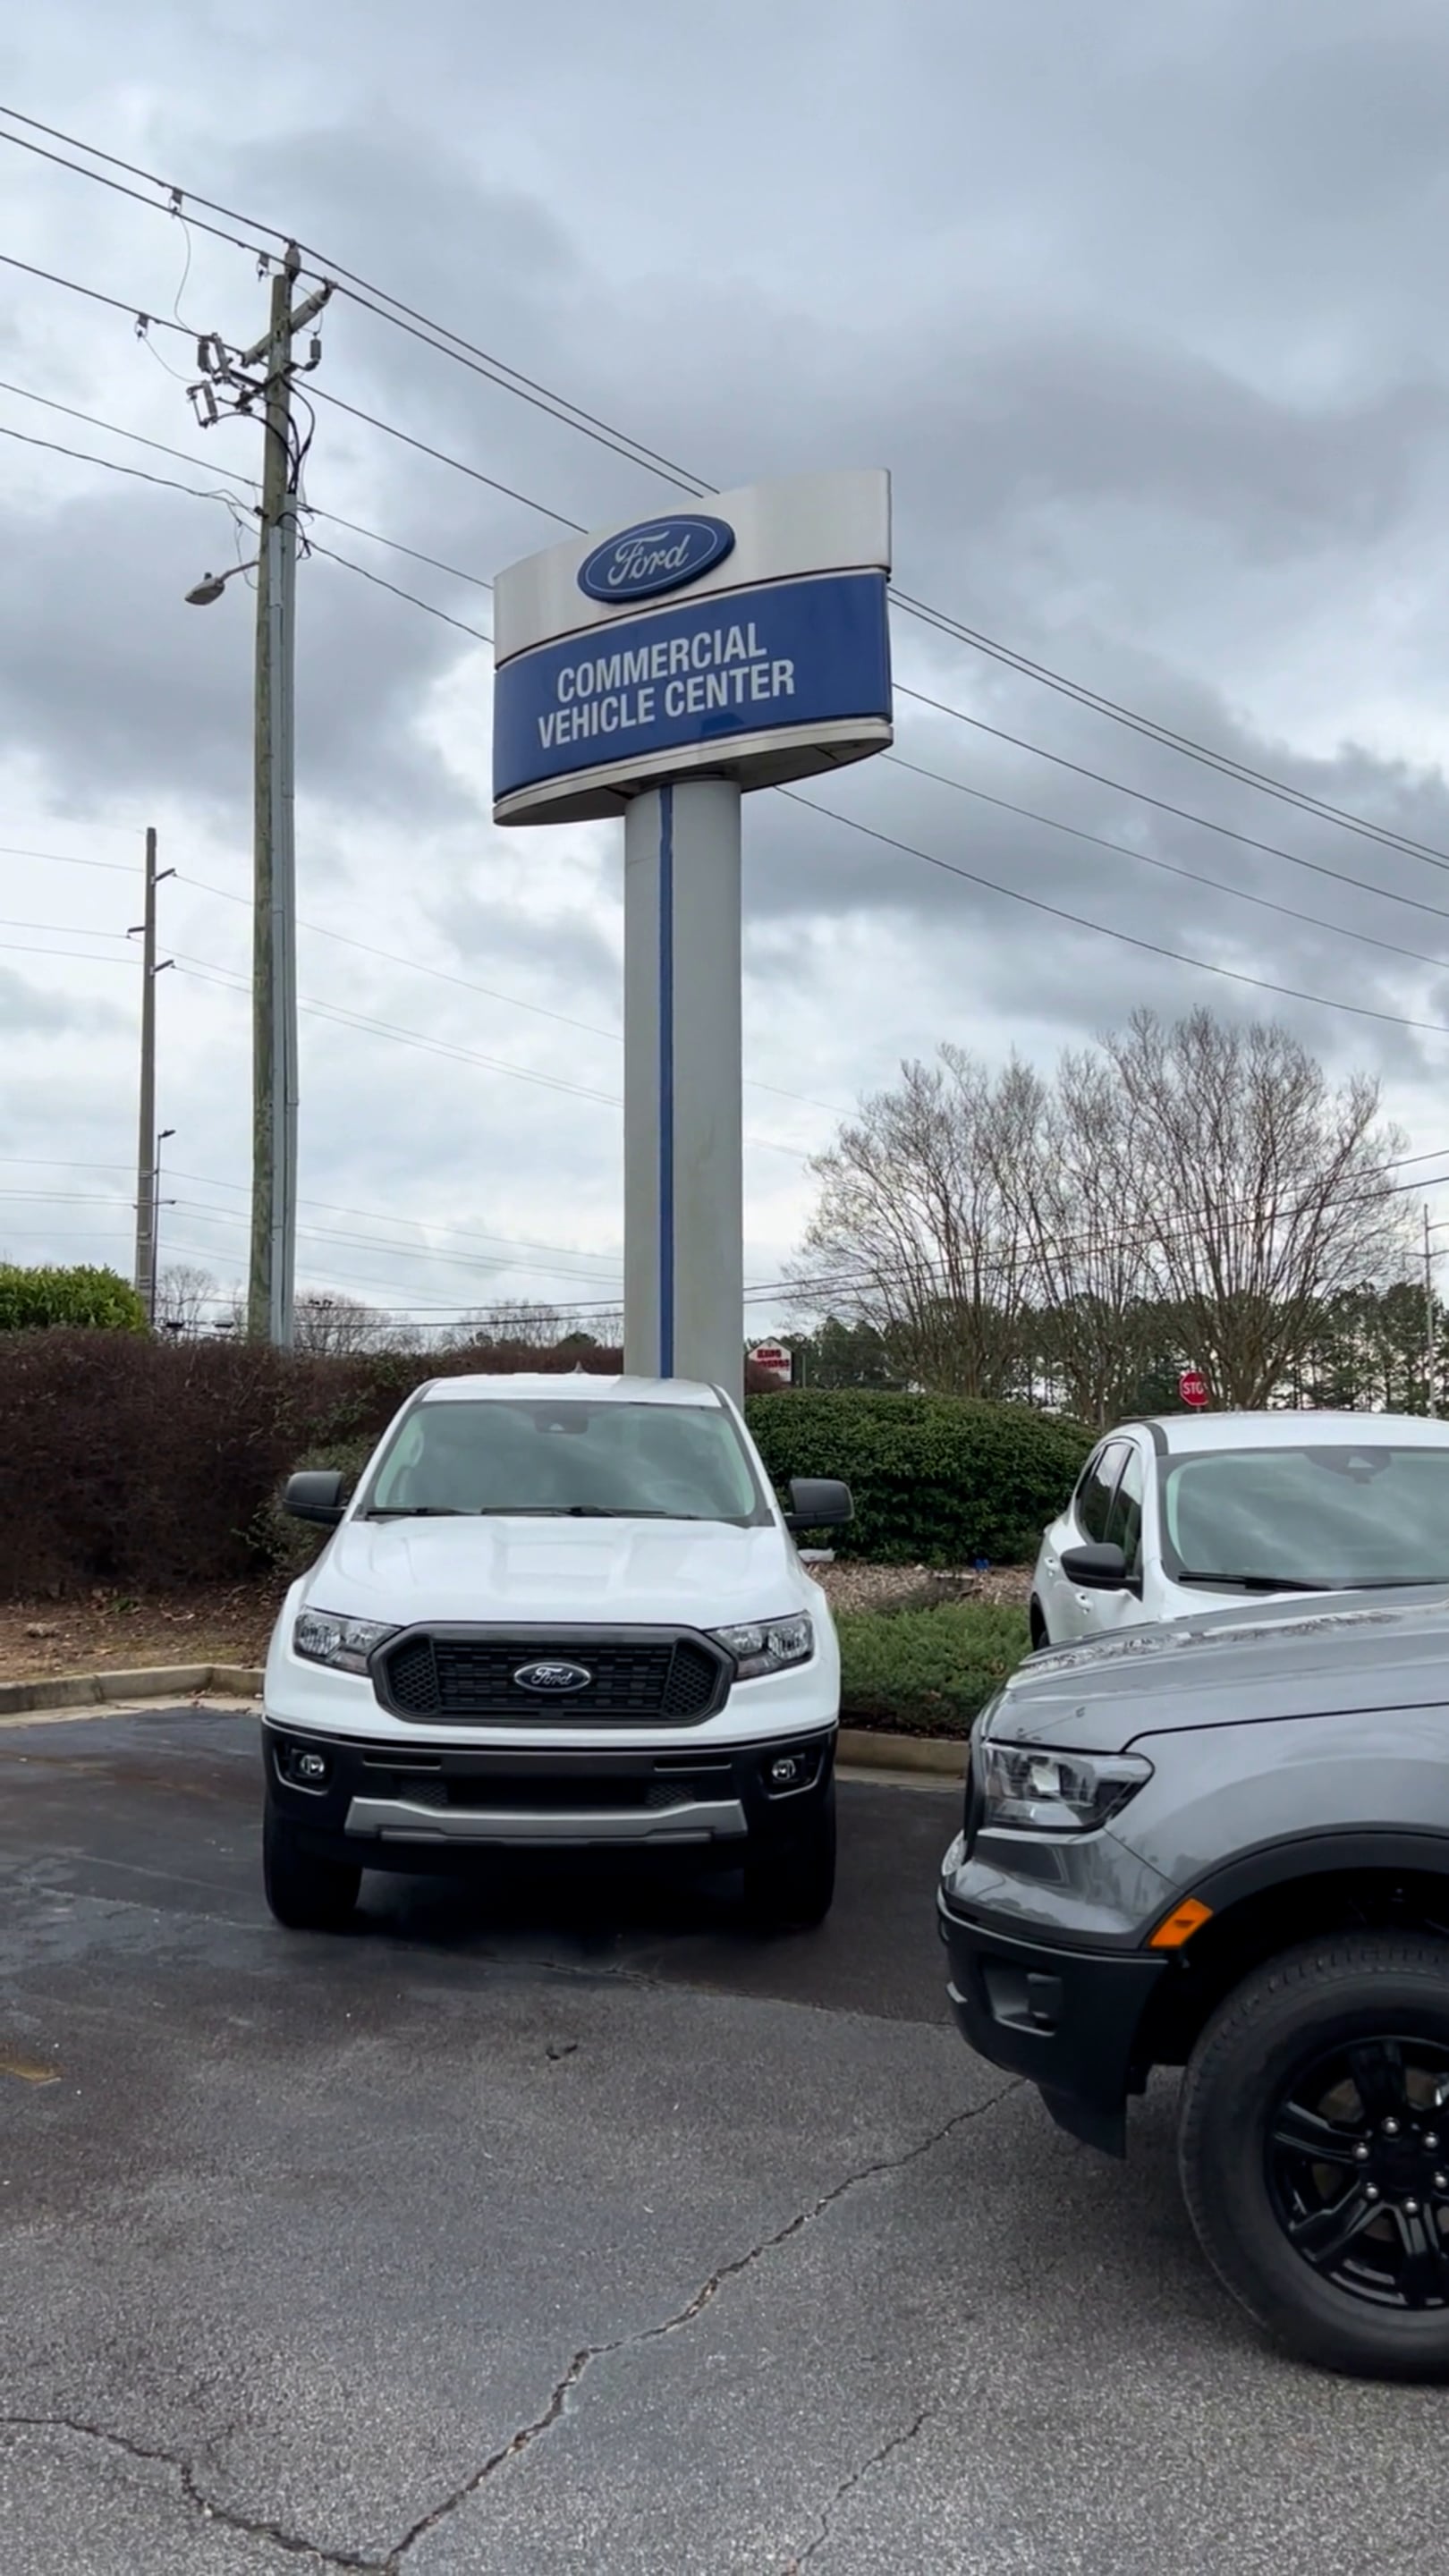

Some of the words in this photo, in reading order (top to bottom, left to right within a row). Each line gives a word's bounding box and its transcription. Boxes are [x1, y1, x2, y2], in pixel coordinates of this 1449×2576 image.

[608, 531, 691, 586] Ford
[557, 623, 767, 703] COMMERCIAL
[538, 687, 656, 750] VEHICLE
[665, 659, 795, 717] CENTER
[1183, 1381, 1204, 1395] STO
[531, 1665, 573, 1685] Ford
